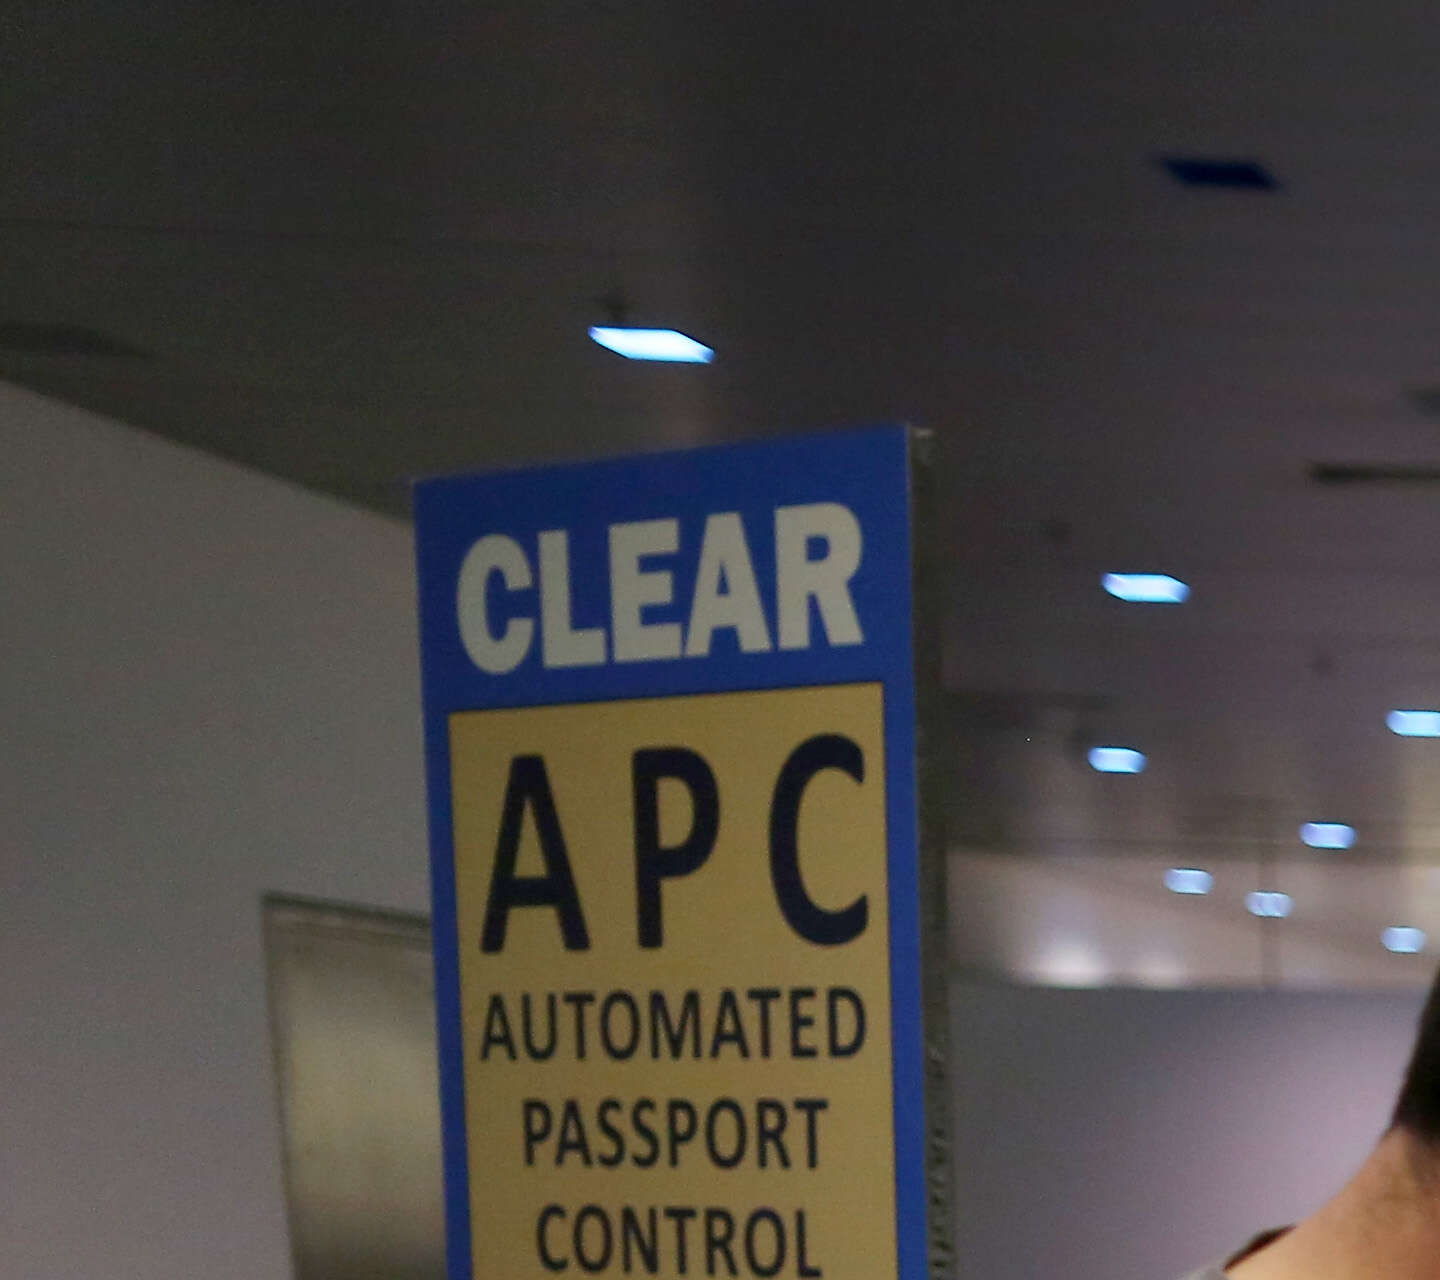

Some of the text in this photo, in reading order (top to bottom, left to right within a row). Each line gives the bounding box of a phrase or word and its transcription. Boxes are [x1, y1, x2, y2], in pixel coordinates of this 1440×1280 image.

[456, 502, 864, 675] CLEAR
[480, 987, 867, 1062] AUTOMATED
[522, 1098, 829, 1171] PASSPORT
[536, 1204, 822, 1279] CONTROL
